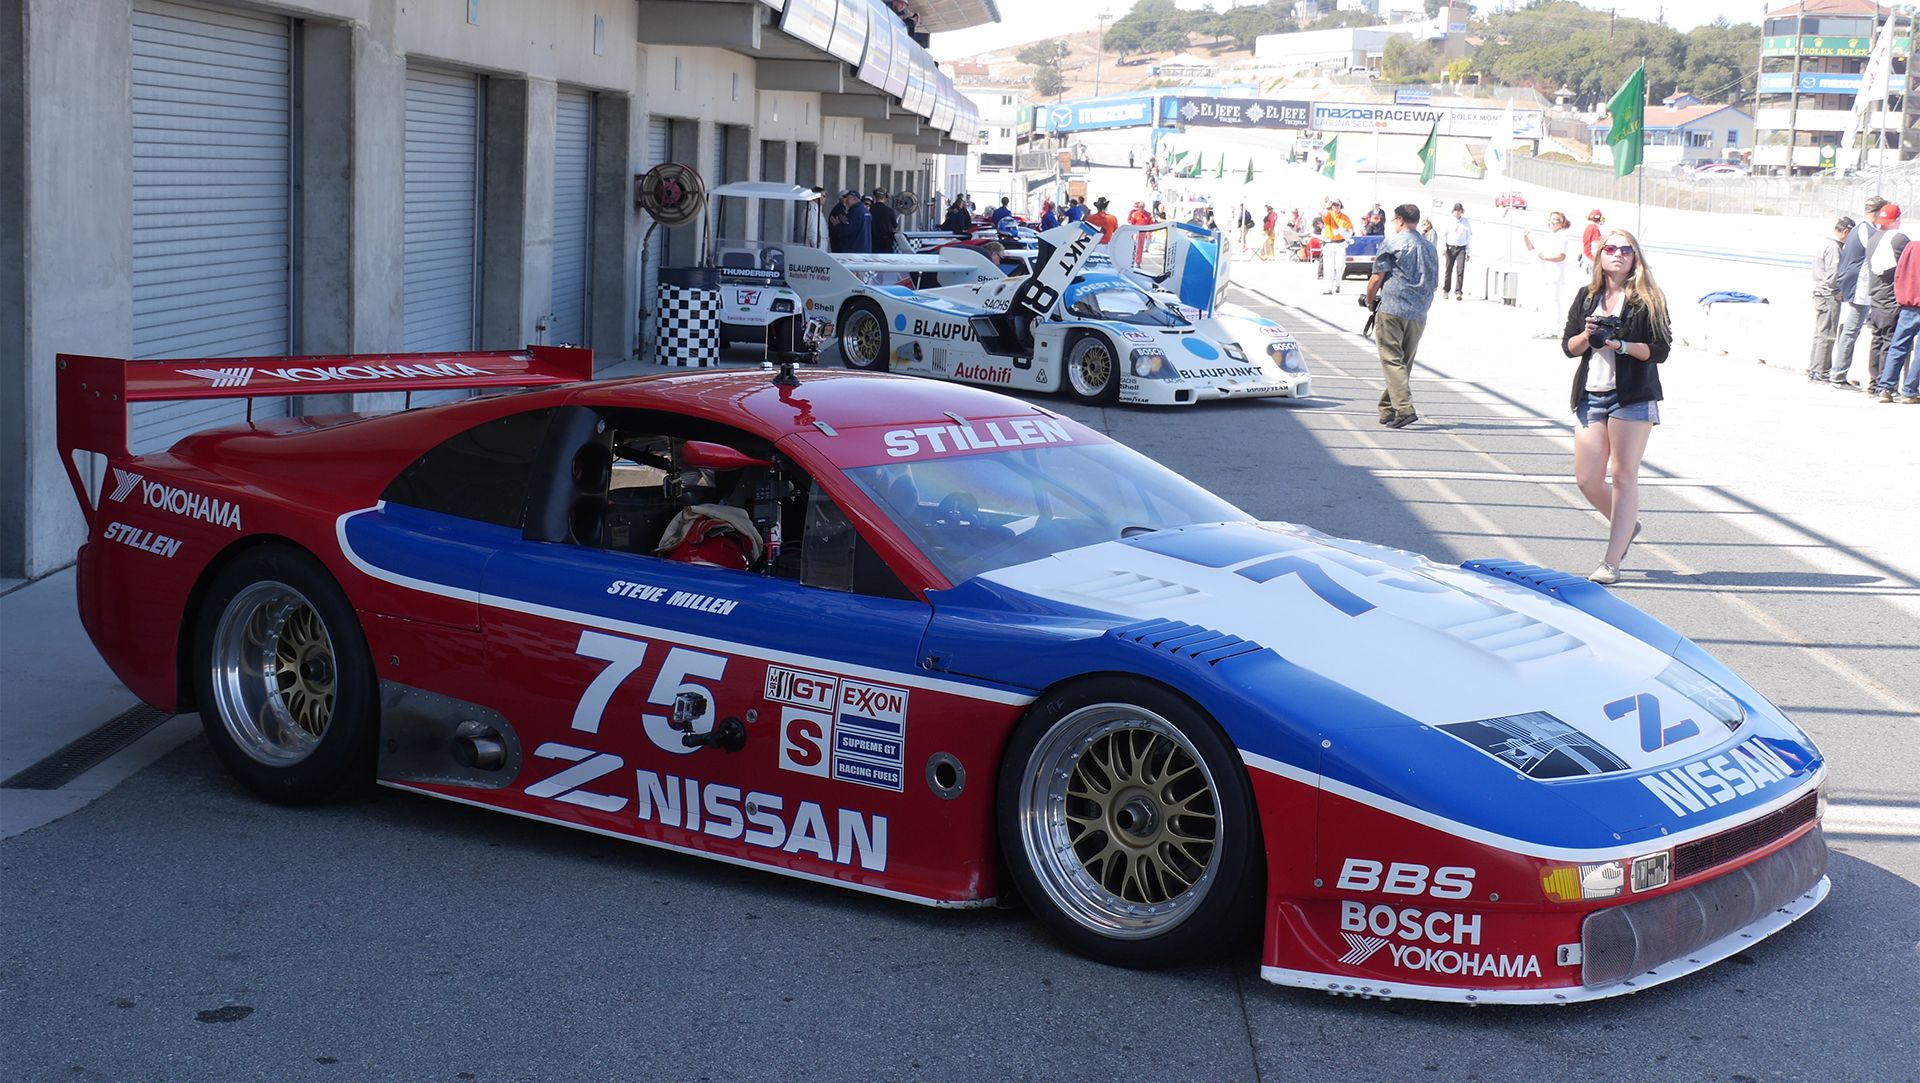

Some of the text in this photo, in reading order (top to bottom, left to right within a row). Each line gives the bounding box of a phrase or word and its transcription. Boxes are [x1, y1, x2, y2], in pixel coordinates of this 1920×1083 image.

[1802, 48, 1833, 56] ROLEX
[1837, 48, 1868, 56] ROLEX
[1201, 103, 1306, 121] EL JEFE EL JEFE
[1316, 107, 1445, 122] mazda RACEWAY
[722, 268, 780, 278] THUNDERBIRD
[788, 264, 831, 275] BLAUPUNKT
[1075, 281, 1112, 297] JOEST
[814, 303, 835, 312] Shell
[982, 299, 1010, 312] SACHS
[1136, 348, 1165, 356] BOSCH
[1271, 342, 1298, 351] BOSCH
[258, 362, 495, 382] YOKOHAMA
[954, 362, 1012, 384] Autohifi
[1179, 367, 1263, 380] BLAUPUNKT
[884, 420, 1073, 457] STILLEN
[142, 479, 242, 531] YOKOHAMA
[104, 522, 182, 558] STILLEN
[607, 580, 738, 616] STEVE MILLEN
[571, 630, 728, 755] 75
[792, 677, 833, 703] GT
[843, 687, 903, 717] EXXON
[786, 718, 823, 767] S
[842, 736, 897, 755] SUPREME GT
[839, 763, 898, 783] RACING FUELS
[1638, 735, 1795, 818] NISSAN
[636, 768, 888, 873] NISSAN
[1336, 858, 1476, 900] BBS
[1340, 900, 1481, 946] BOSCH
[1389, 943, 1542, 978] YOKOHAMA
